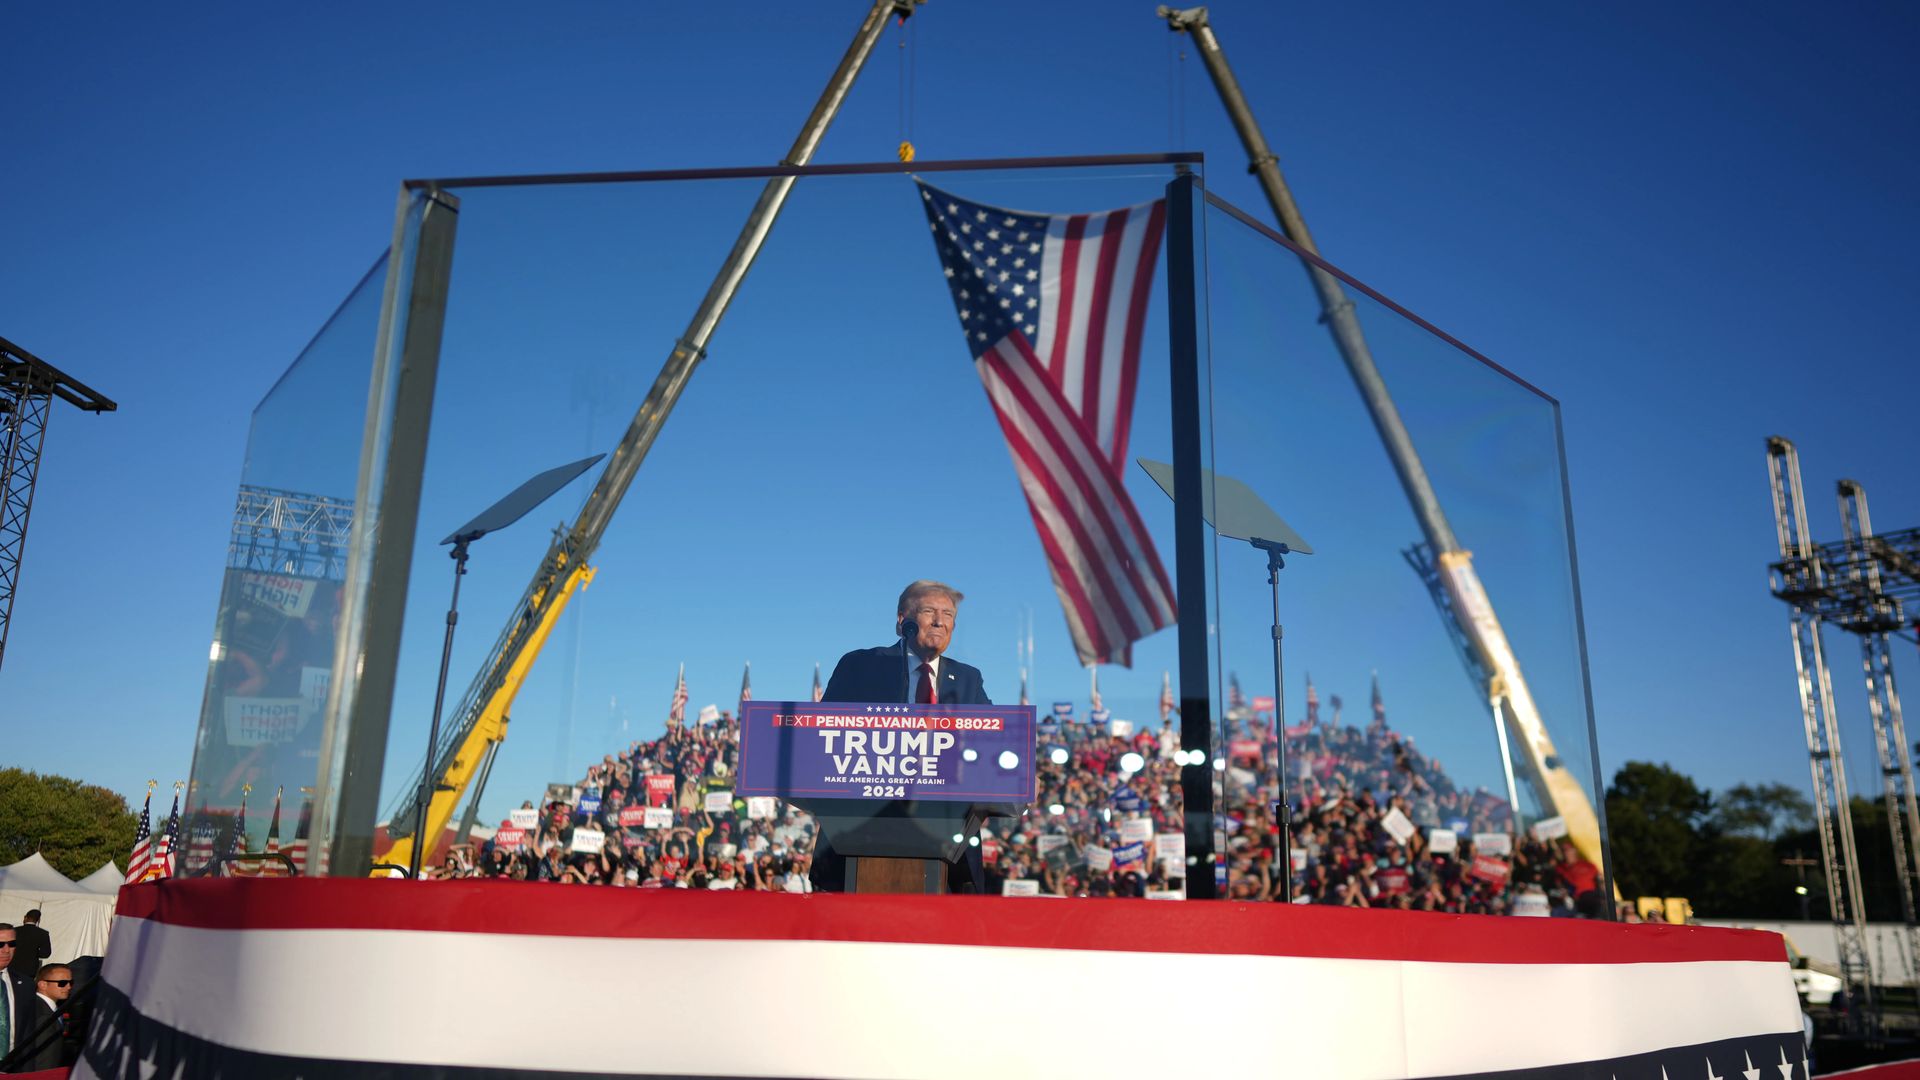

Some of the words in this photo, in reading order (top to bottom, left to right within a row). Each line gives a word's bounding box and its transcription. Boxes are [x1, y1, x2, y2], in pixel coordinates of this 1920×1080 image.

[776, 715, 812, 727] TEXT
[816, 716, 927, 729] PENNSYLVANIA
[931, 718, 951, 729] TO
[955, 718, 1000, 730] 88022
[819, 730, 955, 756] TRUMP
[833, 755, 938, 776] VANCE
[862, 786, 905, 797] 2024
